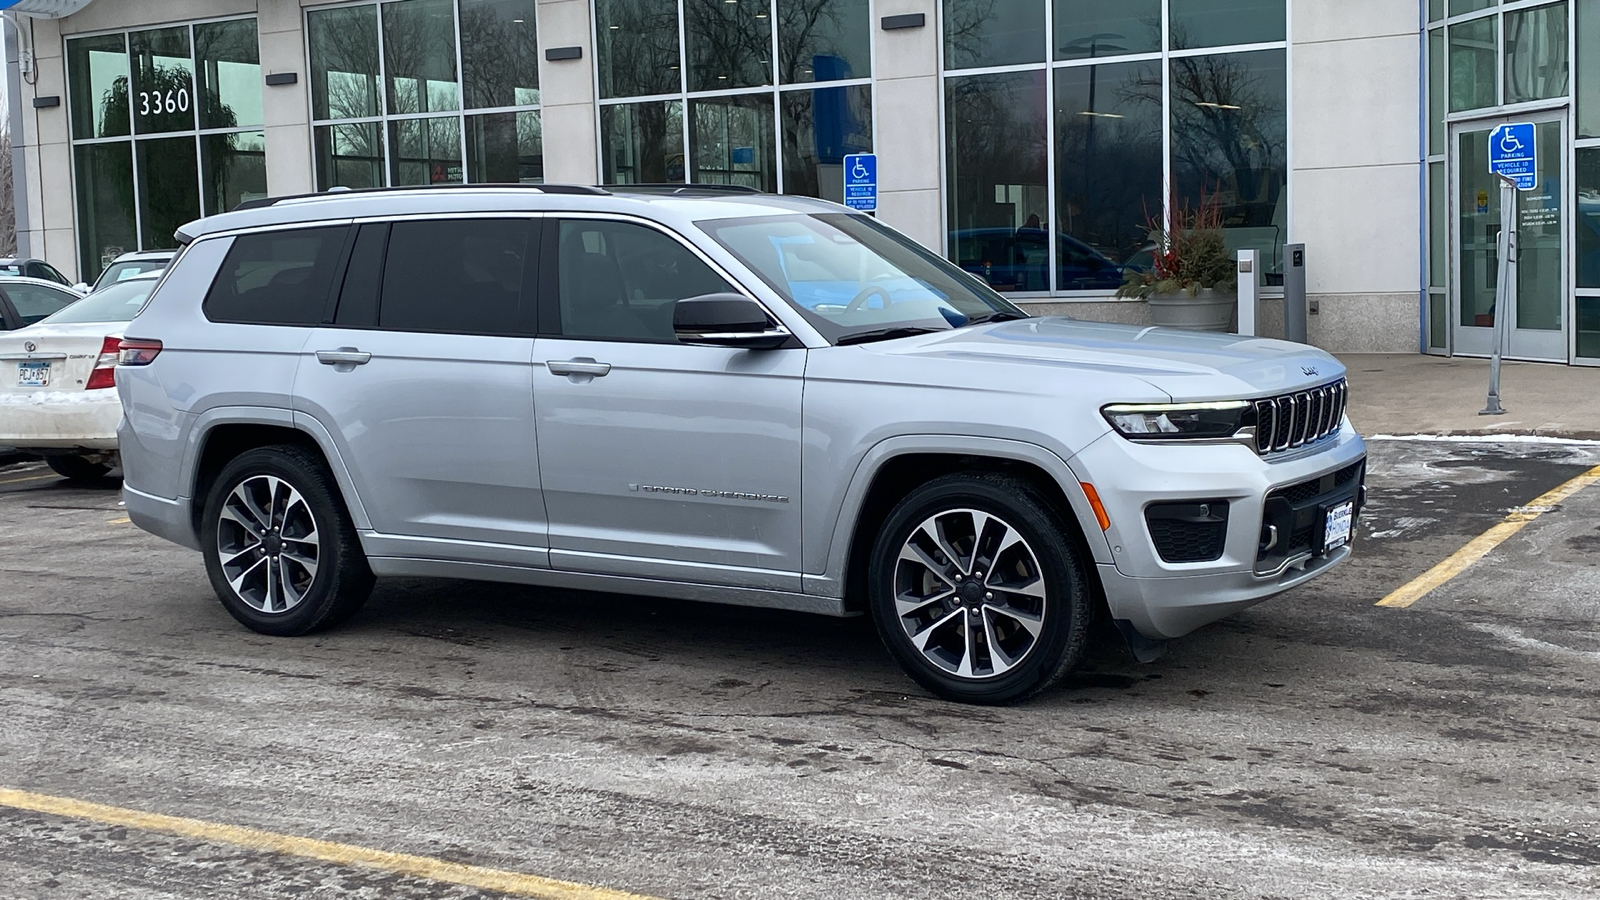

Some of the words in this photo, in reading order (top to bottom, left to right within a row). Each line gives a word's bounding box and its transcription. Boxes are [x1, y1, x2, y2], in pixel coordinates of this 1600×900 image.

[139, 88, 189, 115] 3360
[642, 485, 698, 496] GRAND
[701, 489, 790, 503] CHEROKEE
